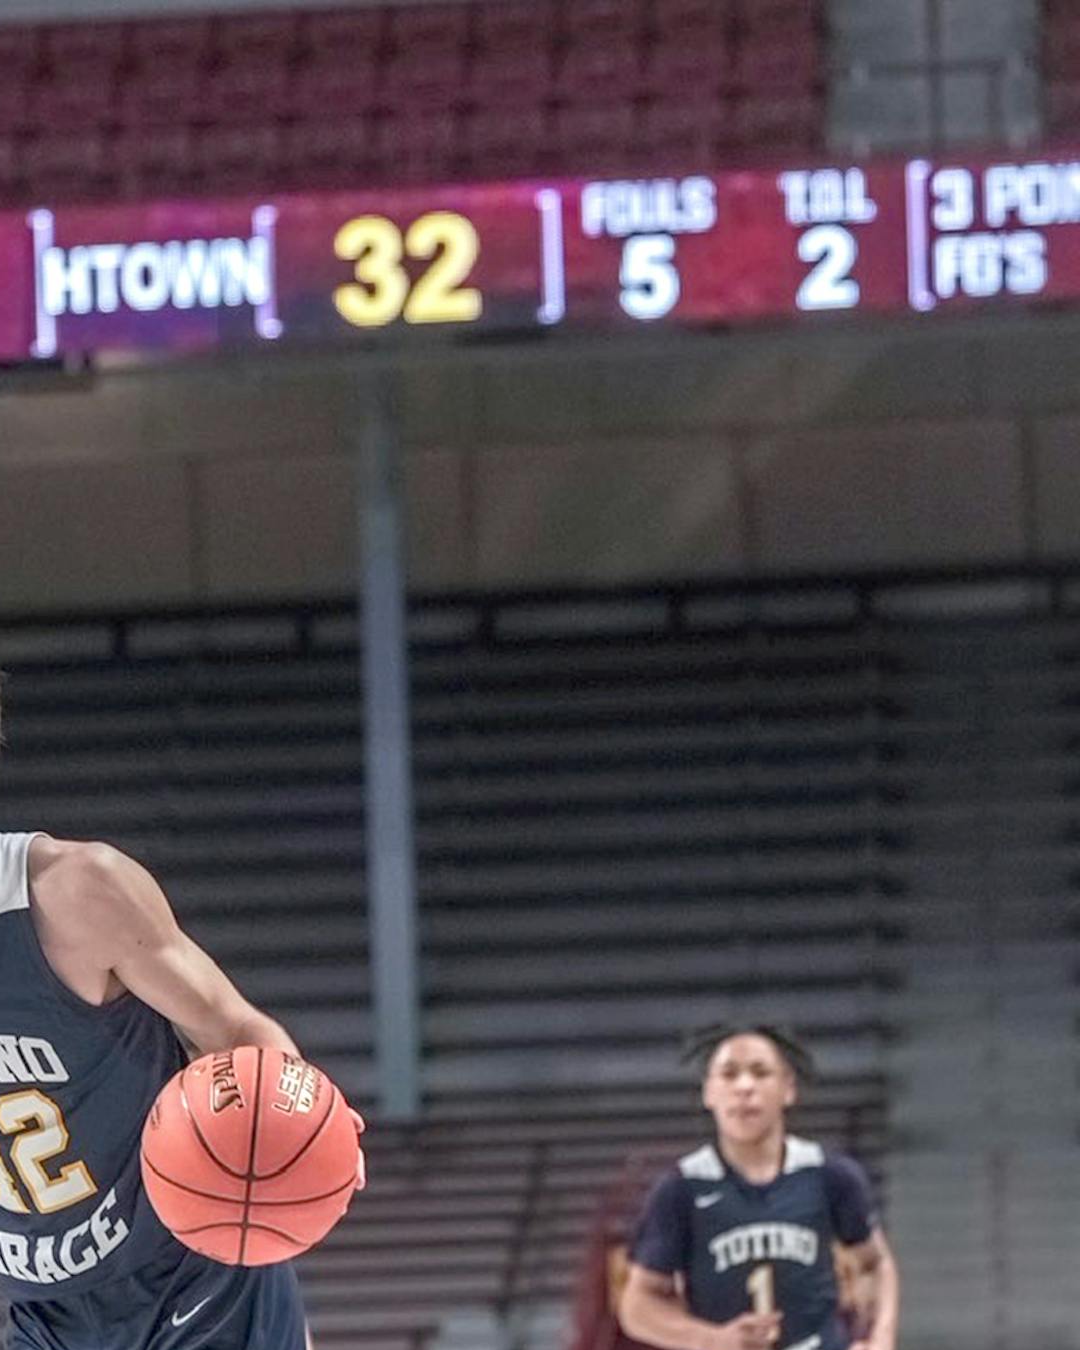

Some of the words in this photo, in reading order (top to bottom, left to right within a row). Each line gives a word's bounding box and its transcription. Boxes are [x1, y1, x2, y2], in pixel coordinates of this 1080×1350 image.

[581, 176, 717, 239] FOULS
[931, 168, 974, 231] 3
[42, 236, 270, 316] HTOWN
[333, 211, 482, 326] 32
[619, 232, 681, 320] 5
[795, 223, 860, 311] 2
[708, 1221, 819, 1274] TOTINO
[746, 1262, 776, 1318] 1
